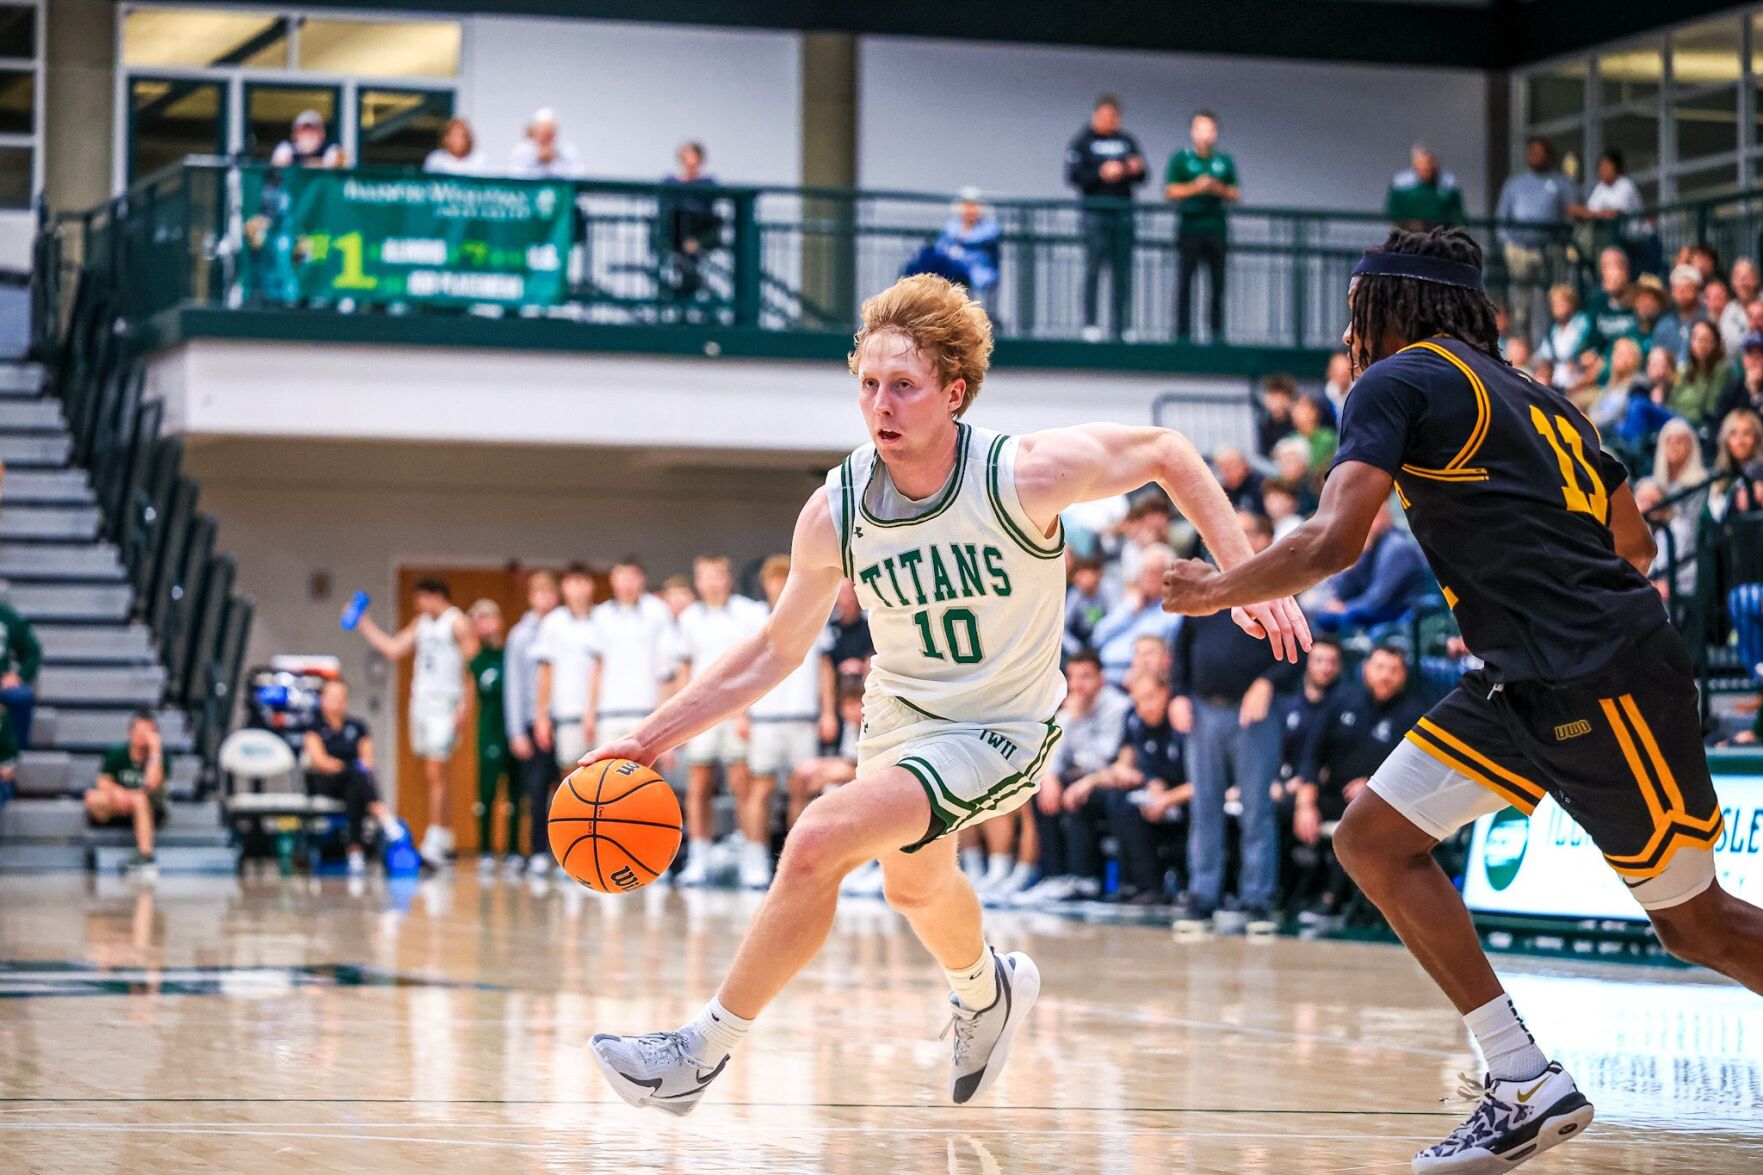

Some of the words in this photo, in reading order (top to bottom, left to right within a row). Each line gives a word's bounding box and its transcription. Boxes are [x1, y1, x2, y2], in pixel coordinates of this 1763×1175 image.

[1529, 404, 1609, 526] 11
[858, 542, 1013, 609] TITANS
[912, 605, 986, 666] 10
[1554, 719, 1592, 741] UWO
